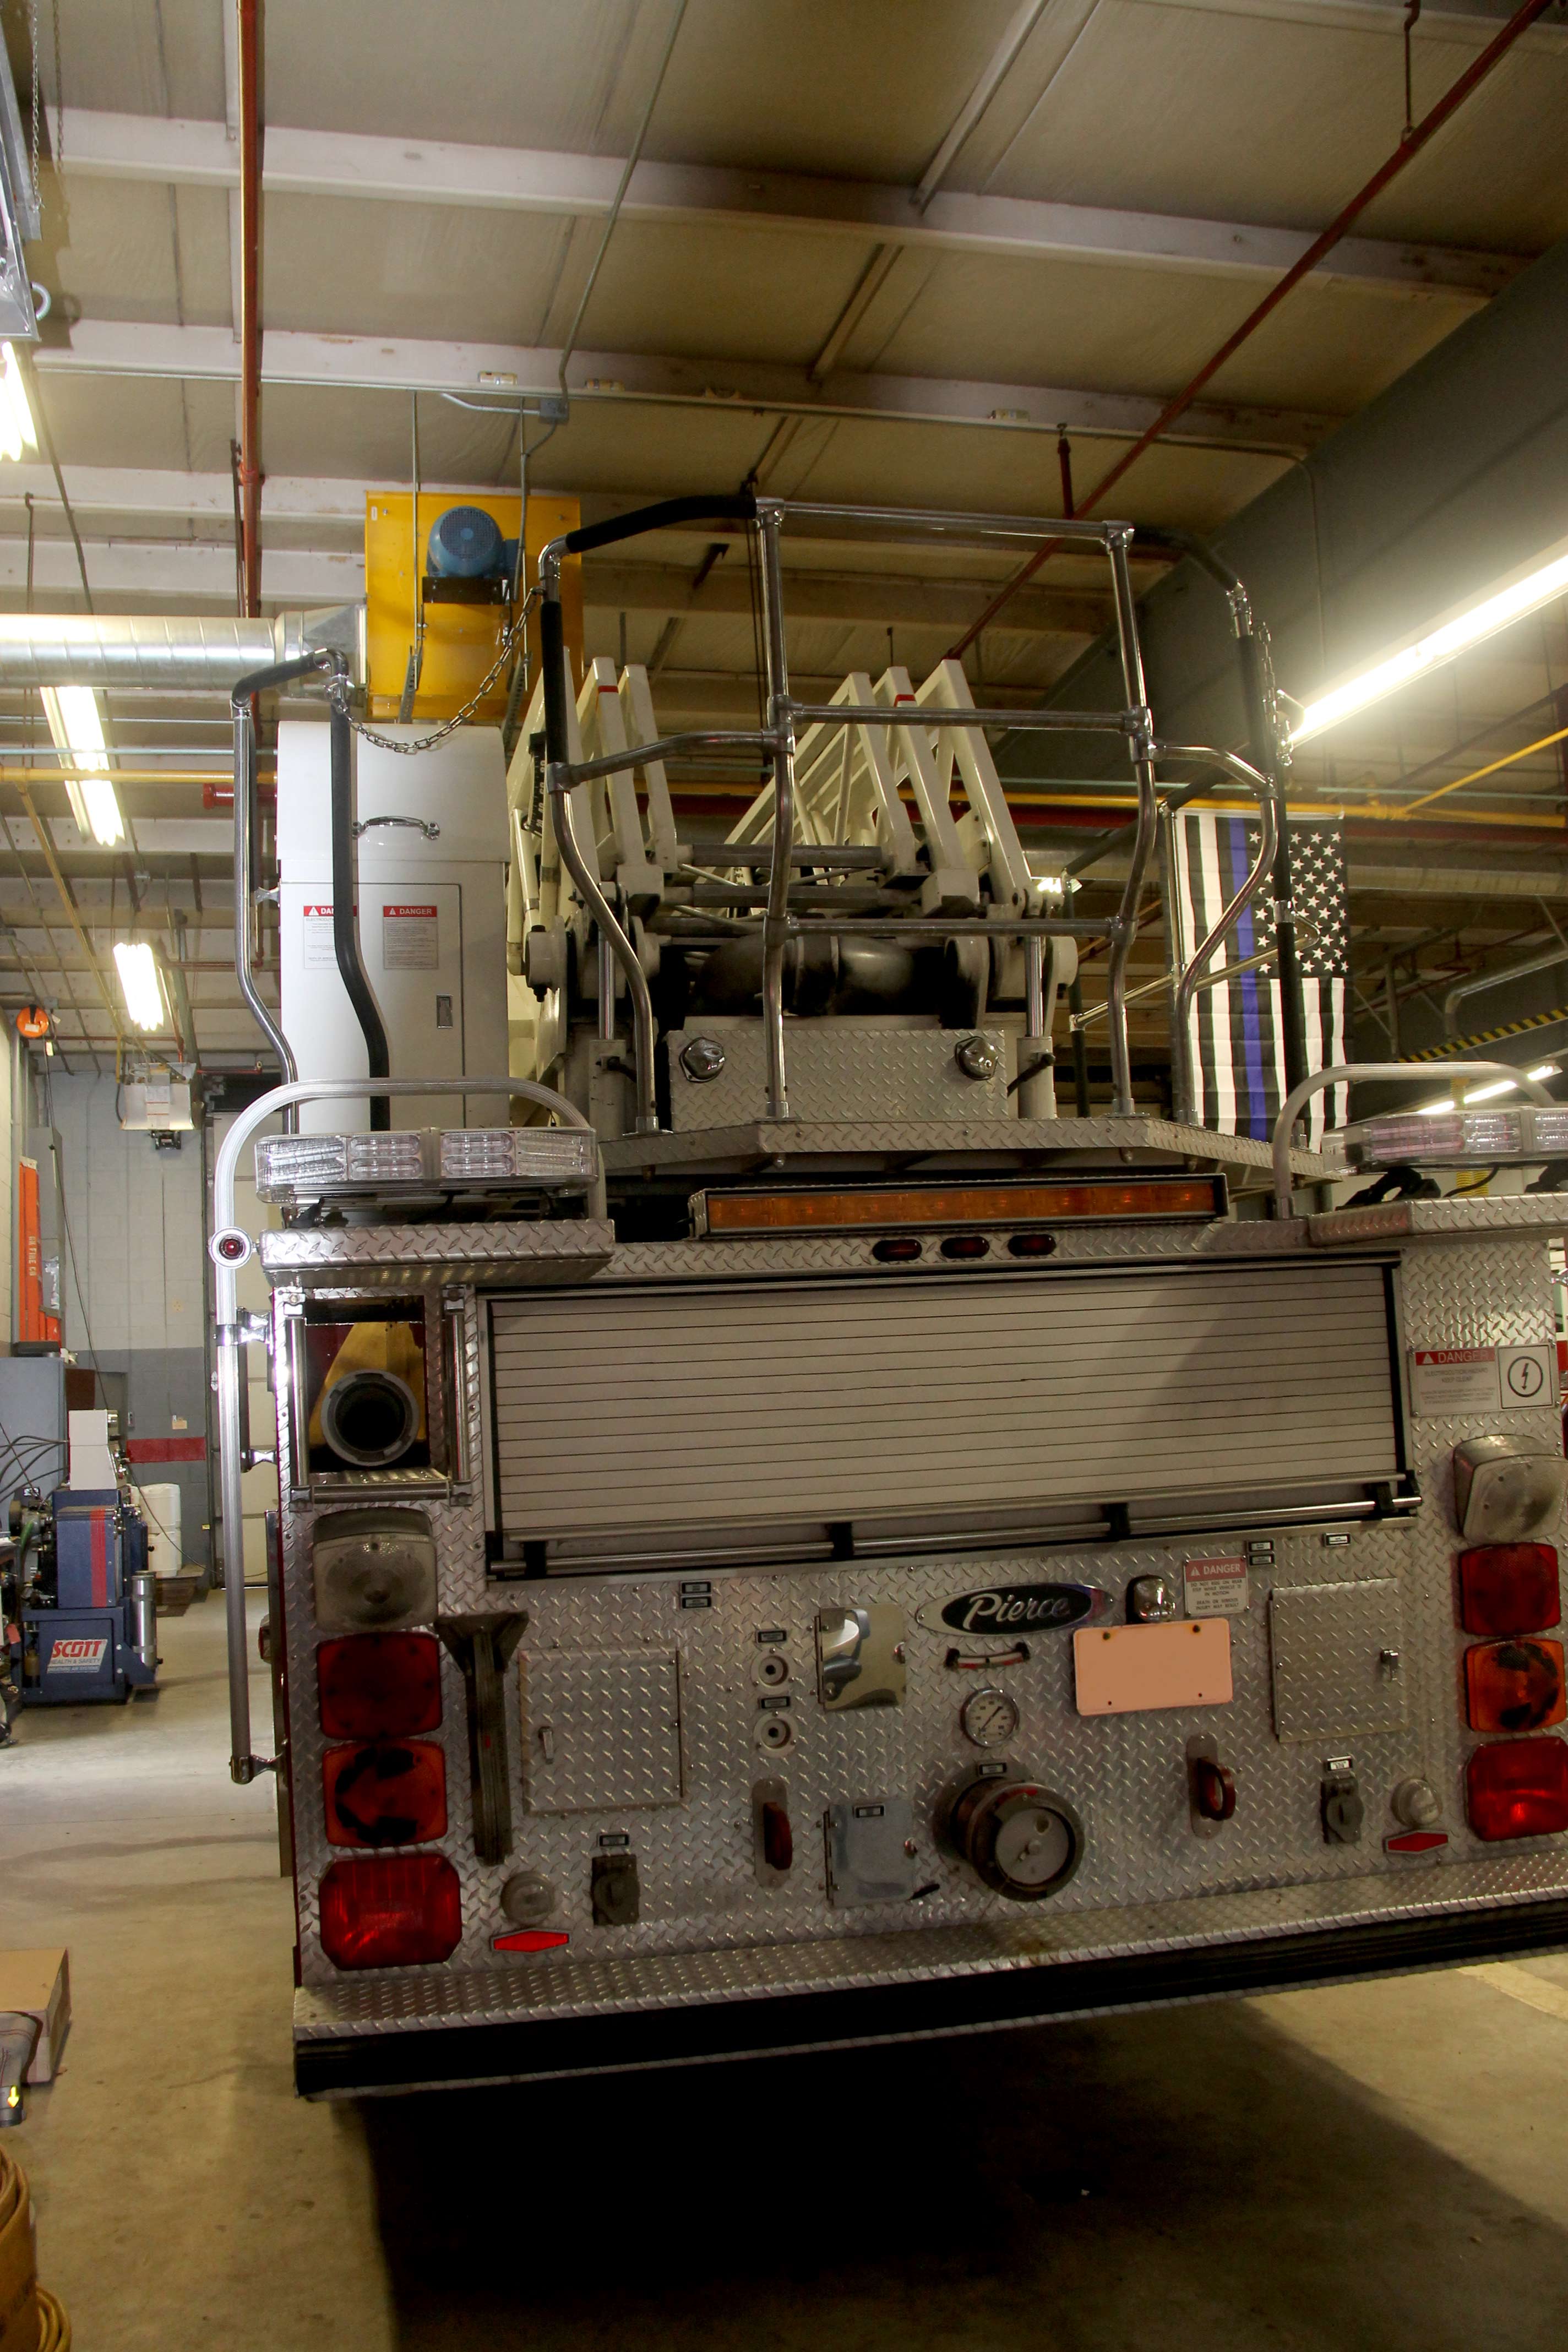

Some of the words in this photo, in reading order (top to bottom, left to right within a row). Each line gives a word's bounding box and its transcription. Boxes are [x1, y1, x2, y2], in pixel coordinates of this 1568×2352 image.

[1438, 1349, 1489, 1363] DANGER
[1203, 1563, 1241, 1575] DANGER
[962, 1593, 1071, 1630] Pierce
[52, 1641, 102, 1658] SCOTT
